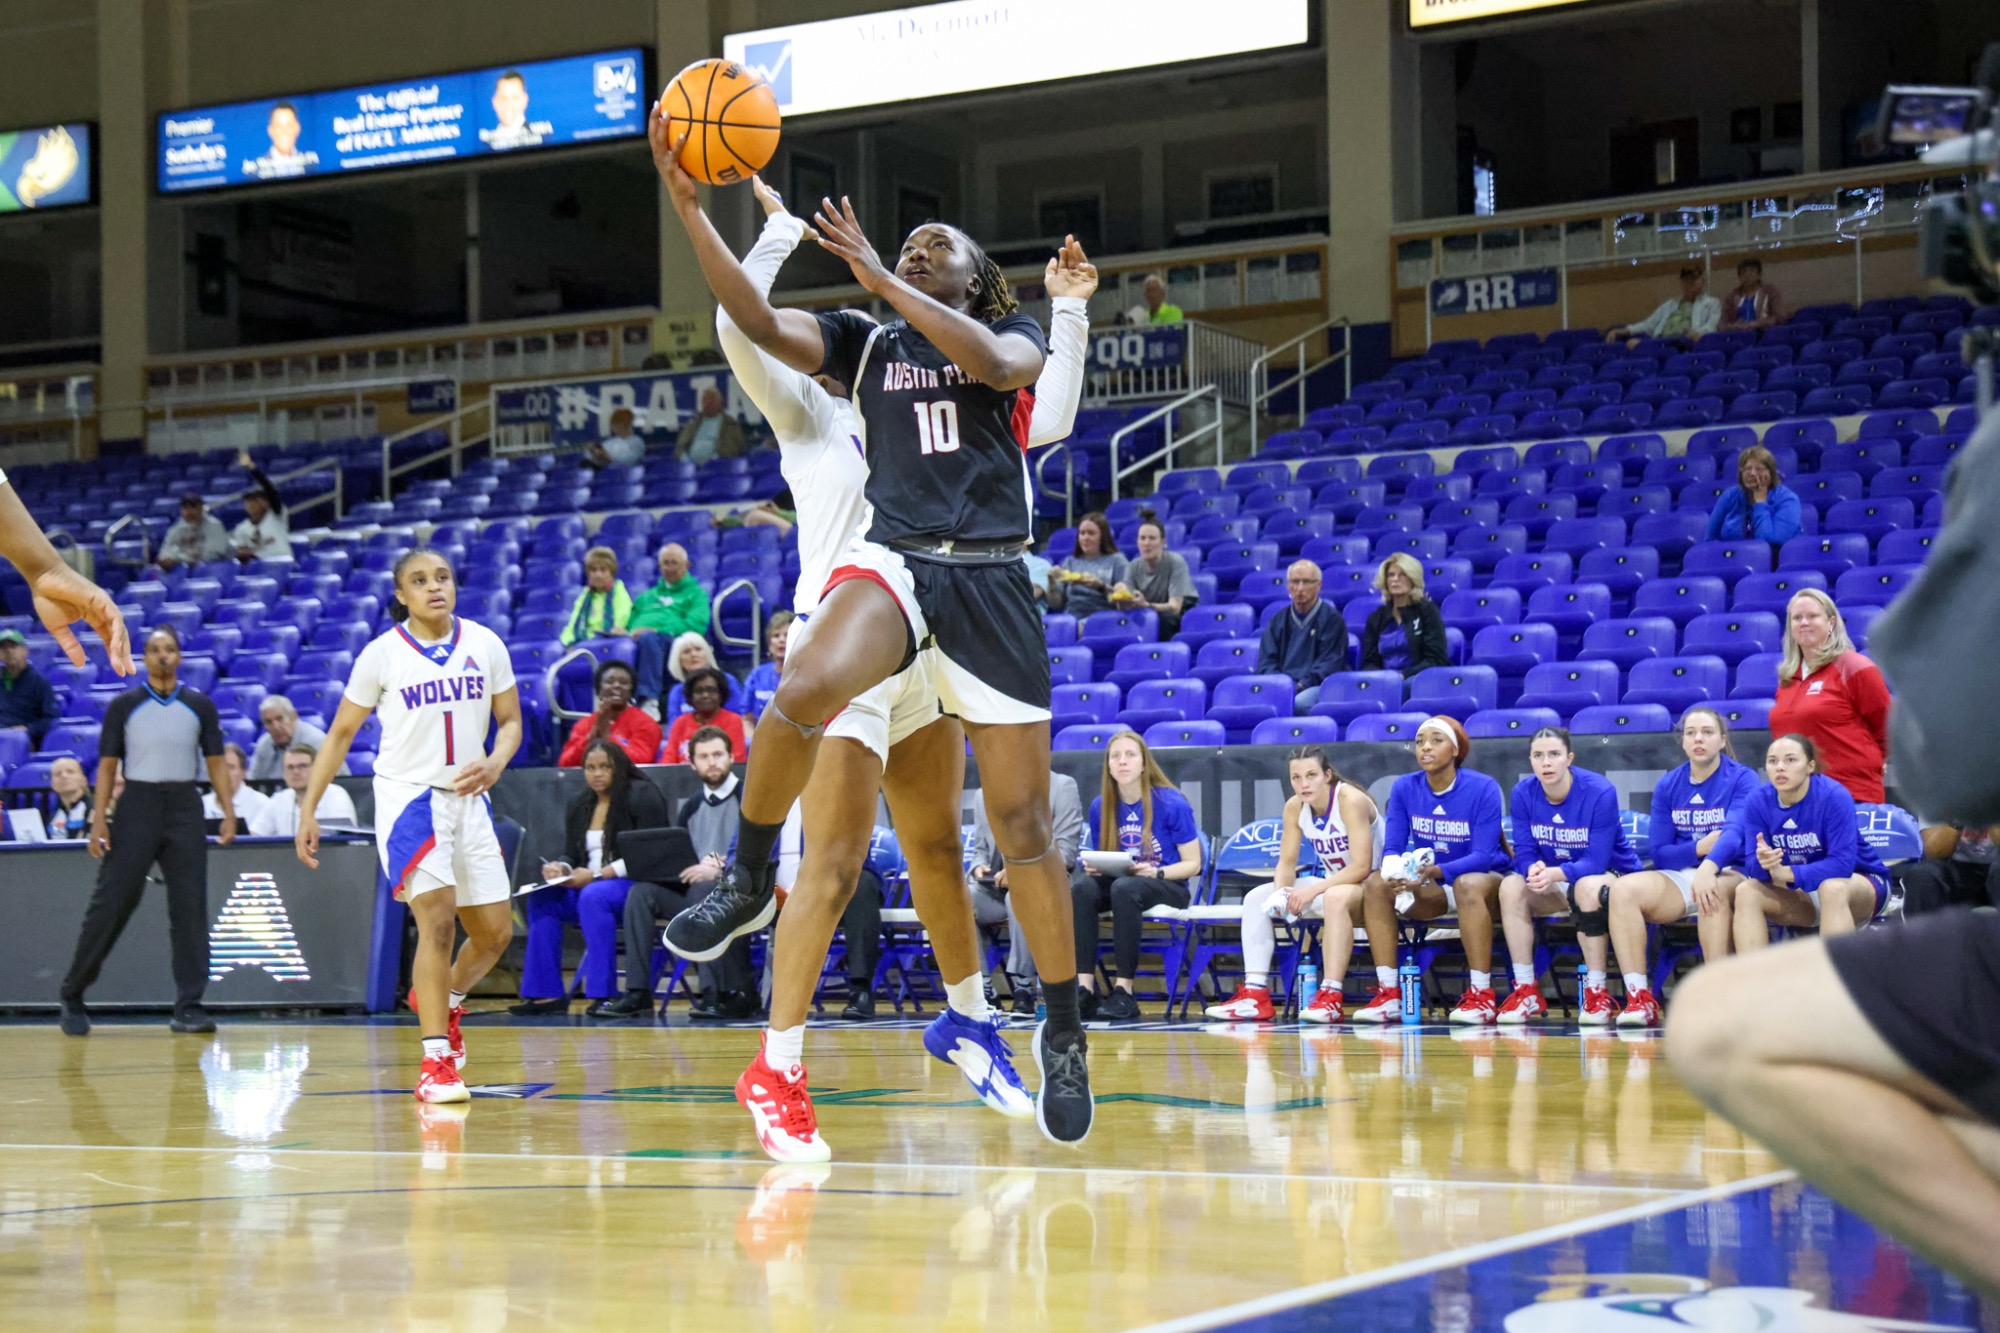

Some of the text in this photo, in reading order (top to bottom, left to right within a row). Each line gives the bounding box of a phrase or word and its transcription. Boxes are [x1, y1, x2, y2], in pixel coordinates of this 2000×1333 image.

[1465, 275, 1517, 313] RR
[1096, 334, 1145, 369] QQ
[883, 361, 985, 392] AUSTIN PE
[913, 400, 960, 455] 10
[399, 675, 485, 711] WOLVES
[442, 710, 456, 766] 1
[1411, 815, 1471, 836] WEST GEORGIA
[1530, 824, 1554, 841] WEST
[1855, 810, 1894, 831] CH
[1772, 831, 1821, 849] ST GEORGA
